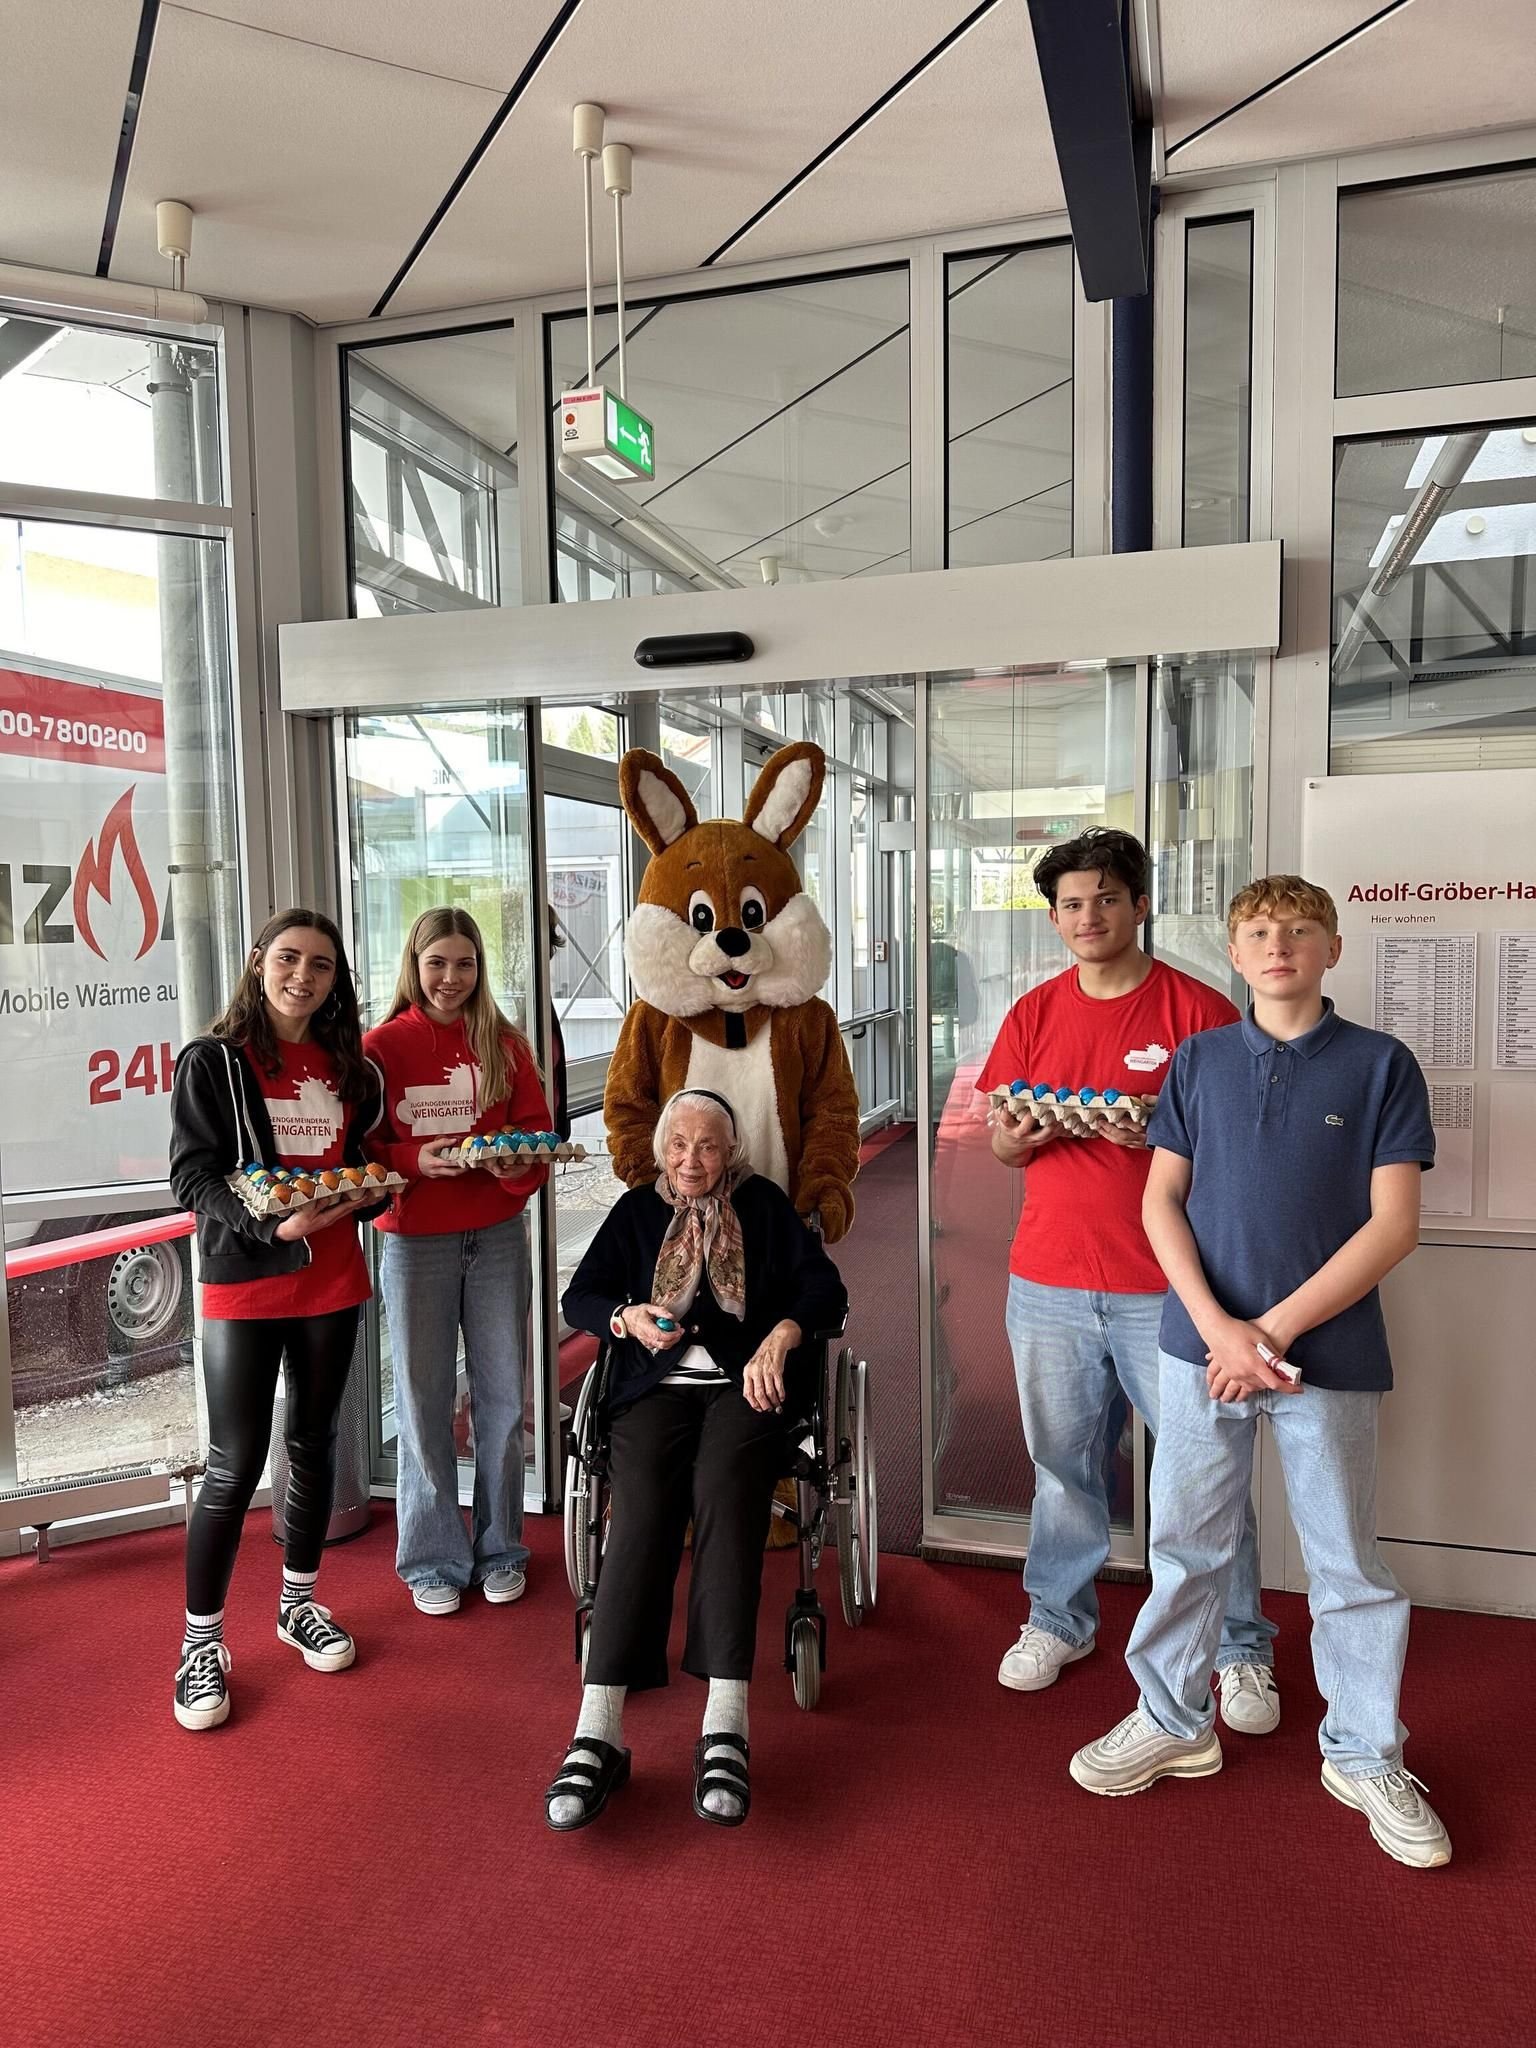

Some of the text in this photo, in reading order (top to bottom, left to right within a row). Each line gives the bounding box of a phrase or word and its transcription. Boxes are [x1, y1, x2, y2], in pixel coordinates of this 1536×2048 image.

[1348, 881, 1536, 902] Adolf-Gröber-Ha
[1371, 914, 1436, 924] Hier wohnen
[76, 983, 151, 1008] Wärme
